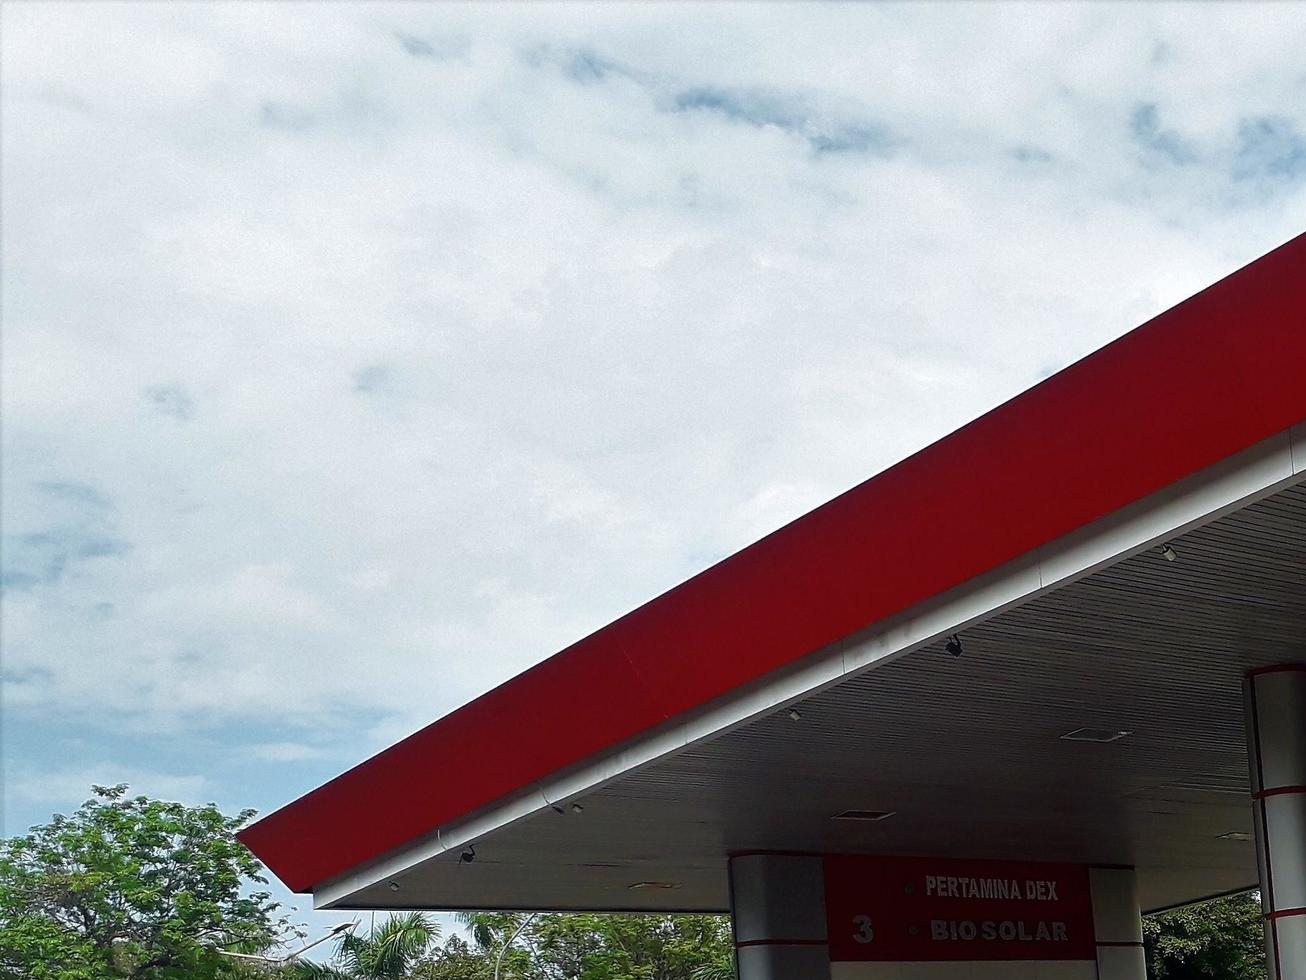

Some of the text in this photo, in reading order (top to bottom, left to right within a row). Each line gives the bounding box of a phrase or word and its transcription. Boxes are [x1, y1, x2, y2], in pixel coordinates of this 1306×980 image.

[926, 875, 1059, 901] PERTAMINA DEX
[852, 914, 874, 944] 3
[930, 919, 1069, 942] BIO SOLAR
